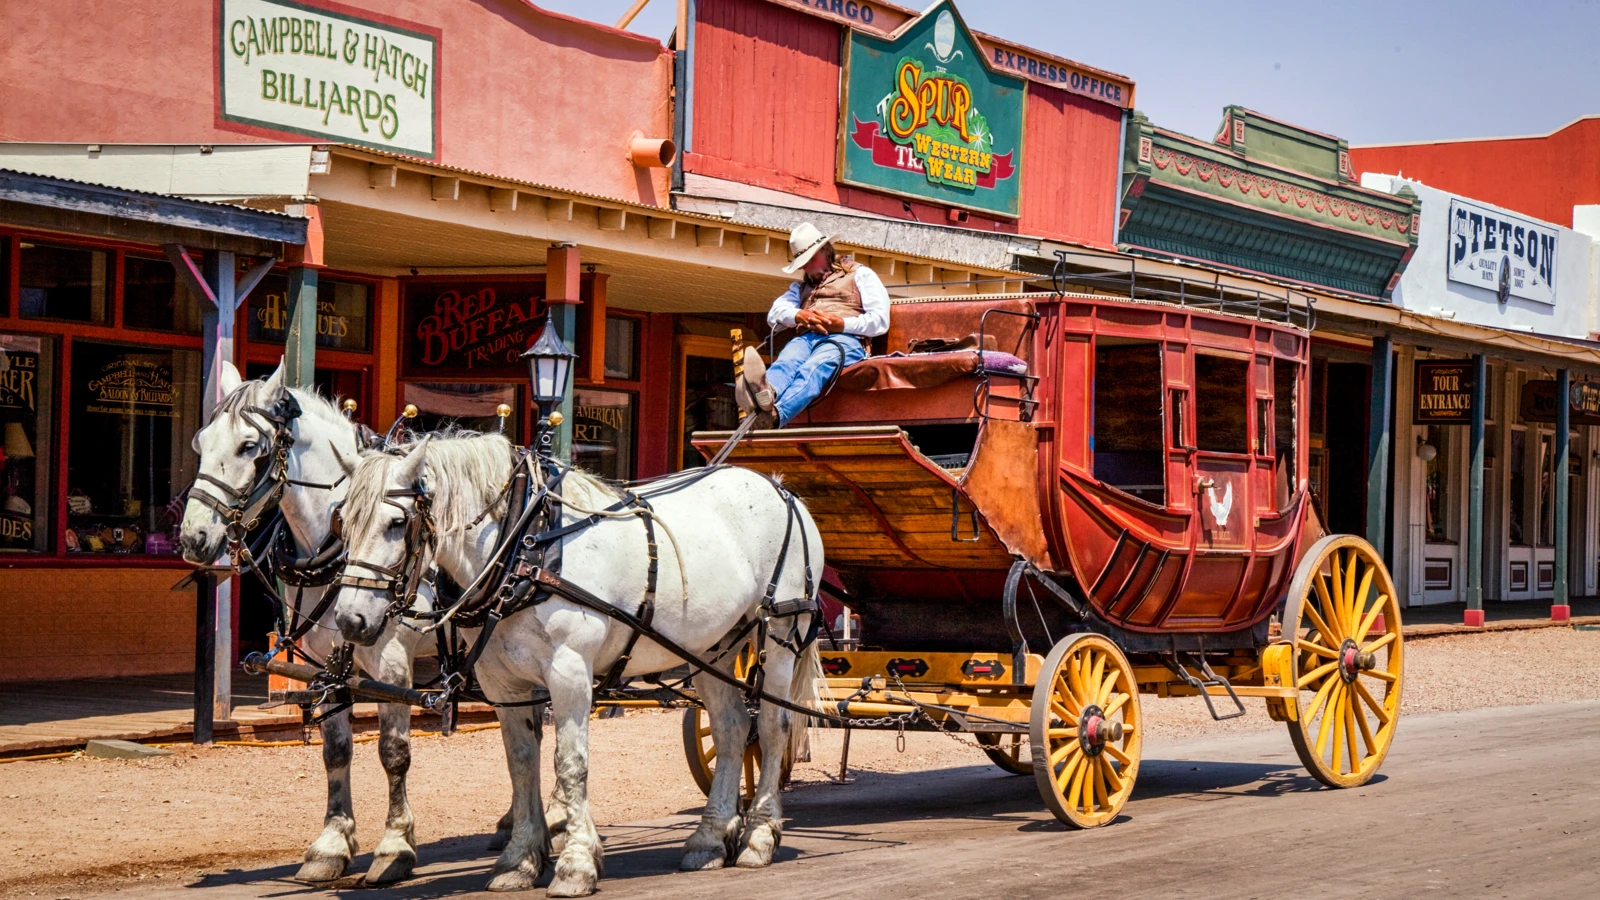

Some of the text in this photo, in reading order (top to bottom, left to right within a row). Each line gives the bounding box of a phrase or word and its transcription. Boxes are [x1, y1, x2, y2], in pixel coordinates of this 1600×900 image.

[801, 0, 874, 24] ARGO
[230, 15, 428, 100] CAMPBELL & HATCH
[935, 65, 948, 74] THE
[993, 47, 1122, 101] EXPRESS OFFICE
[261, 68, 400, 141] BILLIARDS
[890, 61, 980, 143] SPUR
[914, 132, 991, 169] WESTERN
[927, 156, 975, 185] WEAR
[1454, 207, 1555, 289] STETSON
[1478, 258, 1498, 272] QUALITY
[1481, 270, 1494, 282] HATS
[1513, 267, 1526, 279] SINCE
[435, 287, 496, 331] RED
[417, 296, 545, 366] BUFFAL
[464, 329, 524, 369] TRADING
[88, 370, 133, 391] CAMPBELL
[1432, 375, 1460, 392] TOUR
[100, 386, 129, 400] SALOON
[140, 388, 173, 403] BILLIARDS
[1420, 394, 1471, 410] ENTRANCE
[576, 406, 624, 432] AMERICAN
[574, 424, 602, 442] RT
[0, 519, 33, 540] DES
